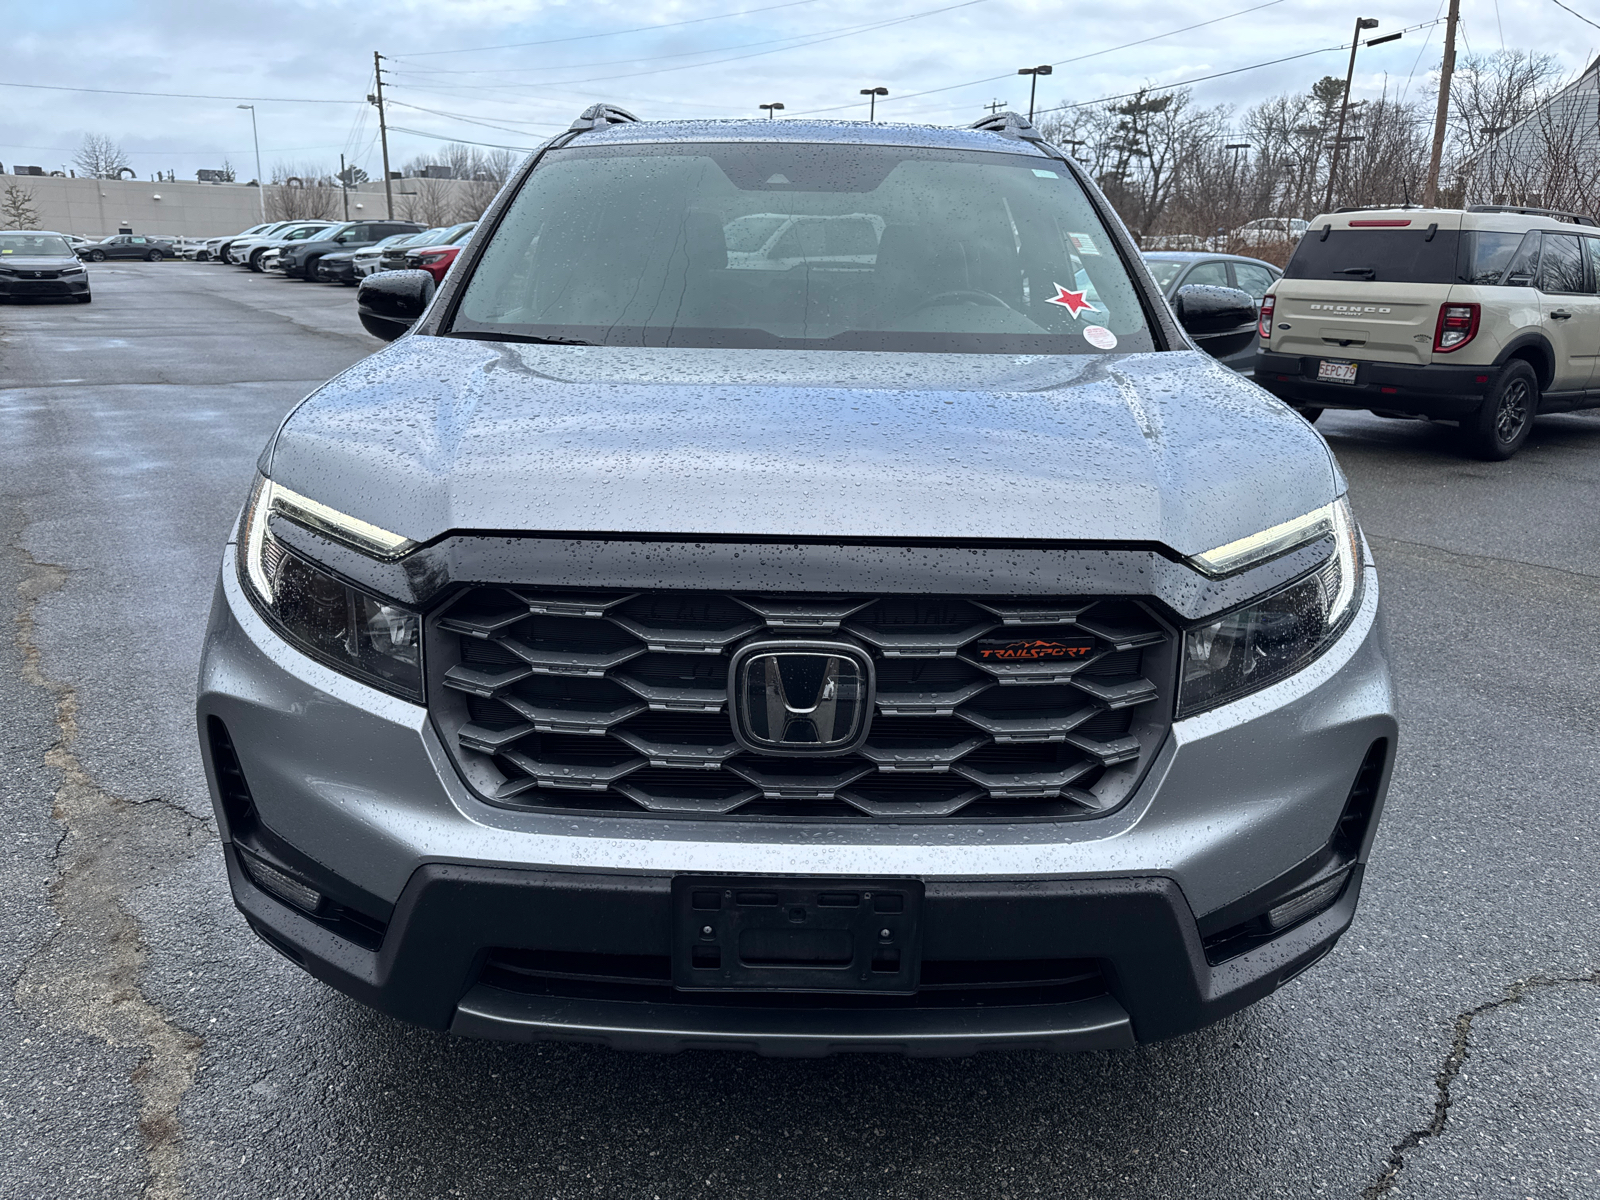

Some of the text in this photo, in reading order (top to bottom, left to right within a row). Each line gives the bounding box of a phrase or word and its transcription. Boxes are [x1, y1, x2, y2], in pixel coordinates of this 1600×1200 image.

[1310, 304, 1391, 314] BRONCO
[1343, 366, 1356, 378] 79
[980, 647, 1092, 659] TRAILSPORT
